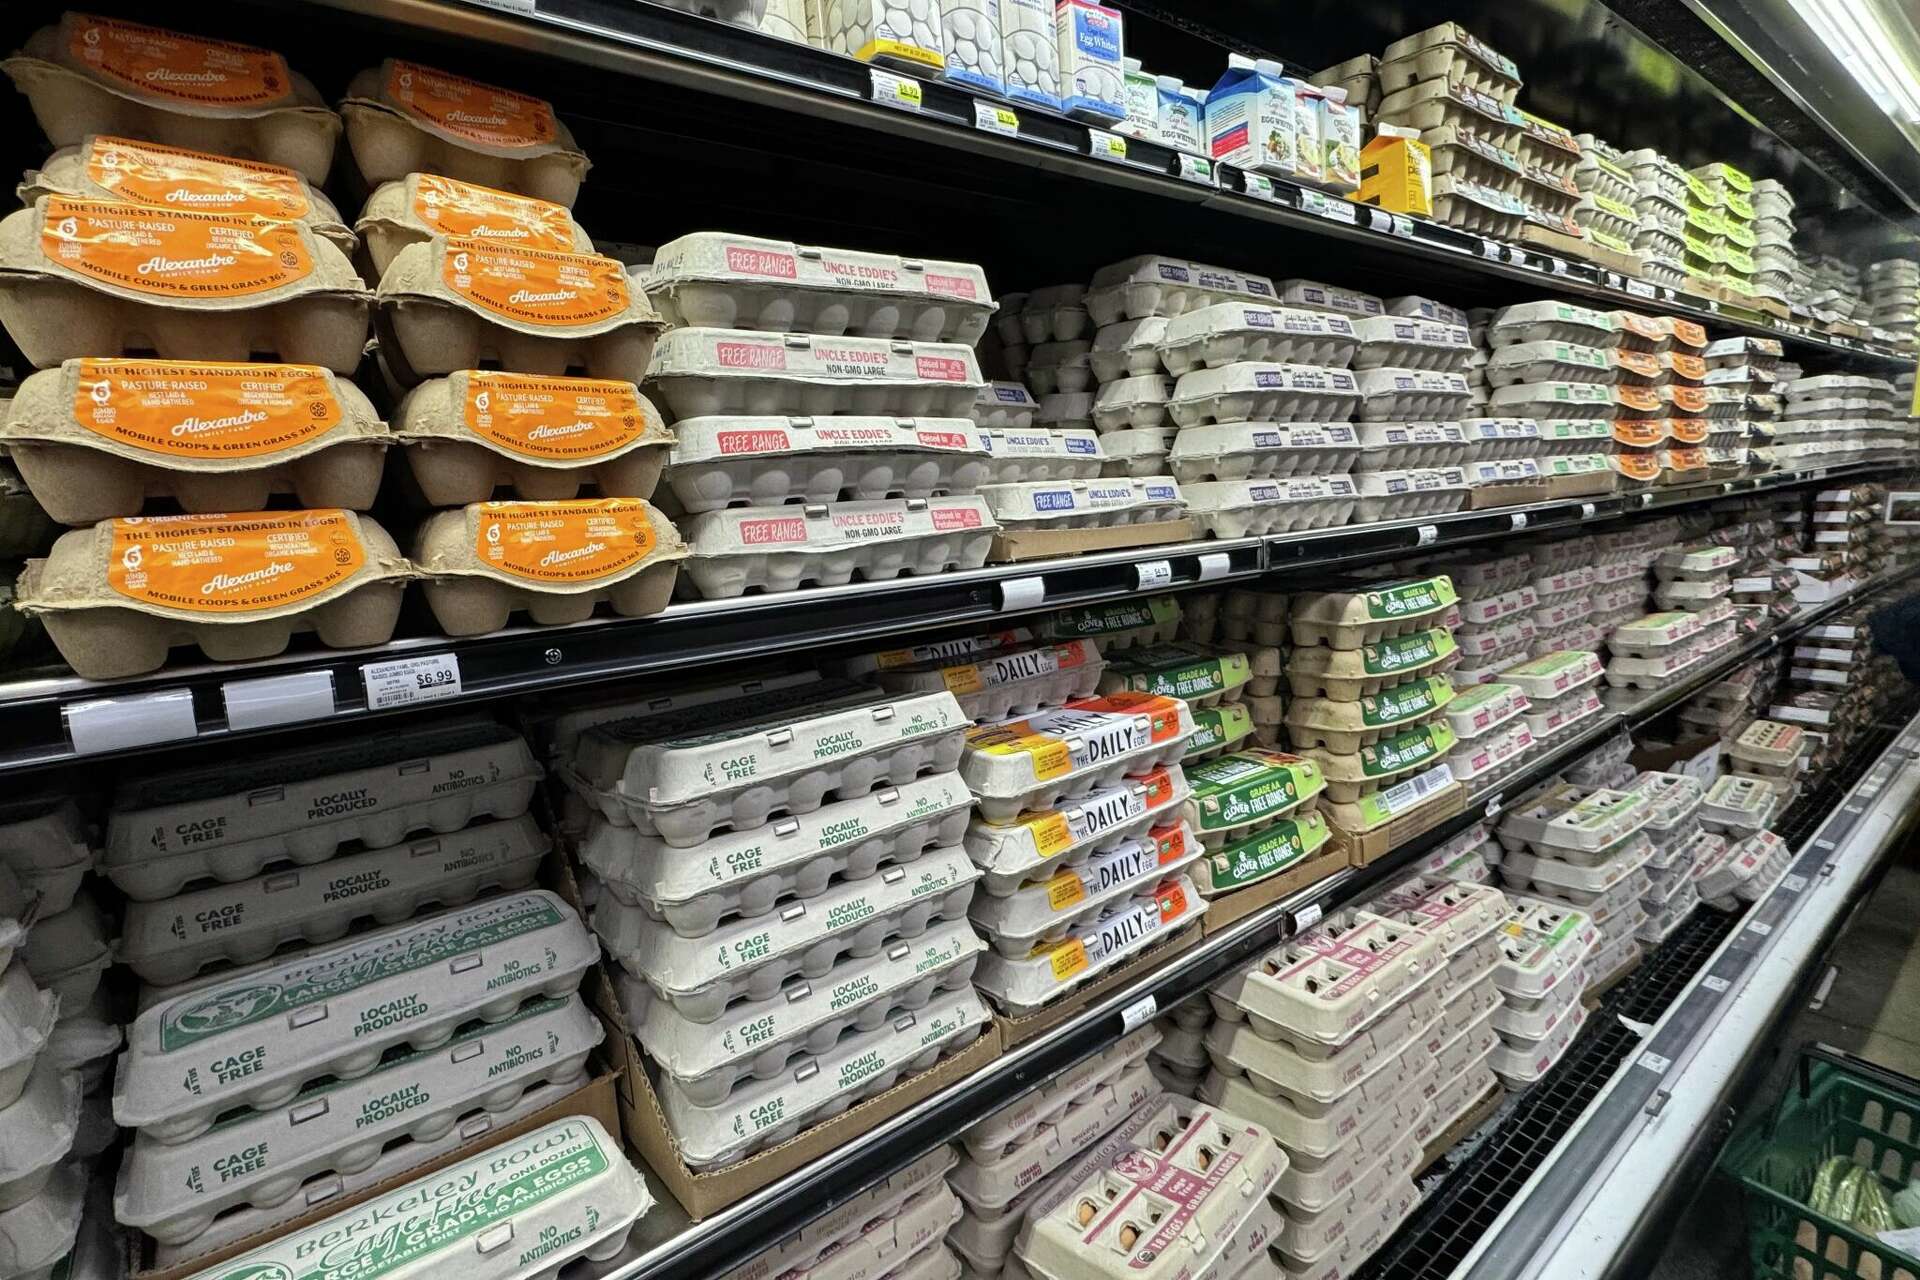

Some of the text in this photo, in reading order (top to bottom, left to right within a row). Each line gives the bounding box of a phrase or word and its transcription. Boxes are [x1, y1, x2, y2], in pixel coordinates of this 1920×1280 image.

[1080, 33, 1118, 52] Egg Whites
[145, 68, 228, 82] Alexandre
[447, 111, 508, 126] Alexandre
[1261, 115, 1275, 125] EGG
[1162, 130, 1177, 139] EGG
[165, 188, 248, 203] Alexandre
[471, 225, 529, 238] Alexandre
[138, 254, 238, 276] Alexandre
[729, 250, 795, 276] FREE RANGE
[822, 260, 898, 281] UNCLE EDDIE'S
[509, 290, 578, 305] Alexandre
[719, 346, 784, 369] FREE RANGE
[814, 349, 889, 364] UNCLE EDDIE'S
[94, 367, 124, 377] THE
[129, 367, 186, 378] HIGHEST
[188, 368, 261, 379] STANDARD
[263, 369, 278, 378] IN
[826, 364, 887, 376] NON-GMO LARGE
[121, 380, 286, 392] PASTURE-RAISED CERTIFIED
[171, 408, 269, 437] Alexandre
[527, 420, 597, 441] Alexandre
[115, 424, 317, 452] MOBILE COOPS GREEN GRASS 365
[721, 431, 788, 452] FREE RANGE
[815, 429, 892, 440] UNCLE EDDIE'S
[1006, 436, 1051, 446] UNCLE EDDIE'S
[1034, 492, 1075, 511] FREE RANGE
[1088, 489, 1132, 500] UNCLE EDDIE'S
[832, 511, 905, 527] UNCLE EDDIE'S
[125, 531, 152, 542] THE
[154, 525, 213, 540] HIGHEST
[216, 521, 287, 535] STANDARD
[288, 519, 302, 529] IN
[743, 521, 805, 543] FREE RANGE
[844, 525, 904, 540] NON-GMO LARGE
[151, 532, 310, 554] PASTURE-RAISED CERTIFIED
[540, 542, 607, 568] Alexandre
[146, 569, 342, 608] MOBILE COOPS & GREEN GRASS 365
[201, 561, 295, 595] Alexandre
[416, 669, 453, 686] $6.99
[1176, 675, 1215, 695] FREE RANGE
[1177, 668, 1210, 682] GRADE AA
[901, 720, 938, 738] ANTIBIOTICS
[911, 714, 923, 725] NO
[814, 739, 863, 760] PRODUCED
[816, 731, 854, 749] LOCALLY
[1076, 756, 1090, 768] THE
[1088, 726, 1134, 762] DAILY
[1133, 736, 1147, 748] EGG
[721, 755, 756, 772] CAGE
[727, 766, 756, 781] FREE
[1249, 780, 1281, 799] GRADE AA
[1223, 791, 1288, 823] CLOVER FREE RANGE
[1076, 828, 1090, 841] THE
[1086, 795, 1130, 834] DAILY
[1129, 802, 1142, 815] EGG
[1258, 835, 1288, 854] GRADE AA
[1090, 852, 1154, 894] THE DAILY EGG
[1232, 846, 1295, 880] CLOVER FREE RANGE
[1093, 912, 1157, 961] THE DAILY EGG
[486, 962, 542, 992] ANTIBIOTICS
[503, 960, 521, 975] NO
[359, 993, 420, 1024] LOCALLY
[354, 1002, 429, 1038] PRODUCED
[930, 1019, 942, 1030] NO
[921, 1021, 957, 1047] ANTIBIOTICS
[210, 1046, 266, 1076] CAGE
[840, 1051, 878, 1076] LOCALLY
[218, 1059, 265, 1086] FREE
[838, 1058, 886, 1088] PRODUCED
[750, 1097, 785, 1120] CAGE
[755, 1108, 785, 1130] FREE
[508, 1143, 583, 1182] ONE DOZEN
[1168, 1177, 1187, 1194] Cage
[406, 1156, 592, 1246] GRADE AA EGGS
[432, 1166, 593, 1244] DIET NO ANTIBIOTICS
[1162, 1219, 1184, 1240] EGGS
[1186, 1185, 1212, 1210] GRADE
[318, 1182, 498, 1272] Cage Free
[519, 1224, 582, 1268] NO ANTIBIOTICS
